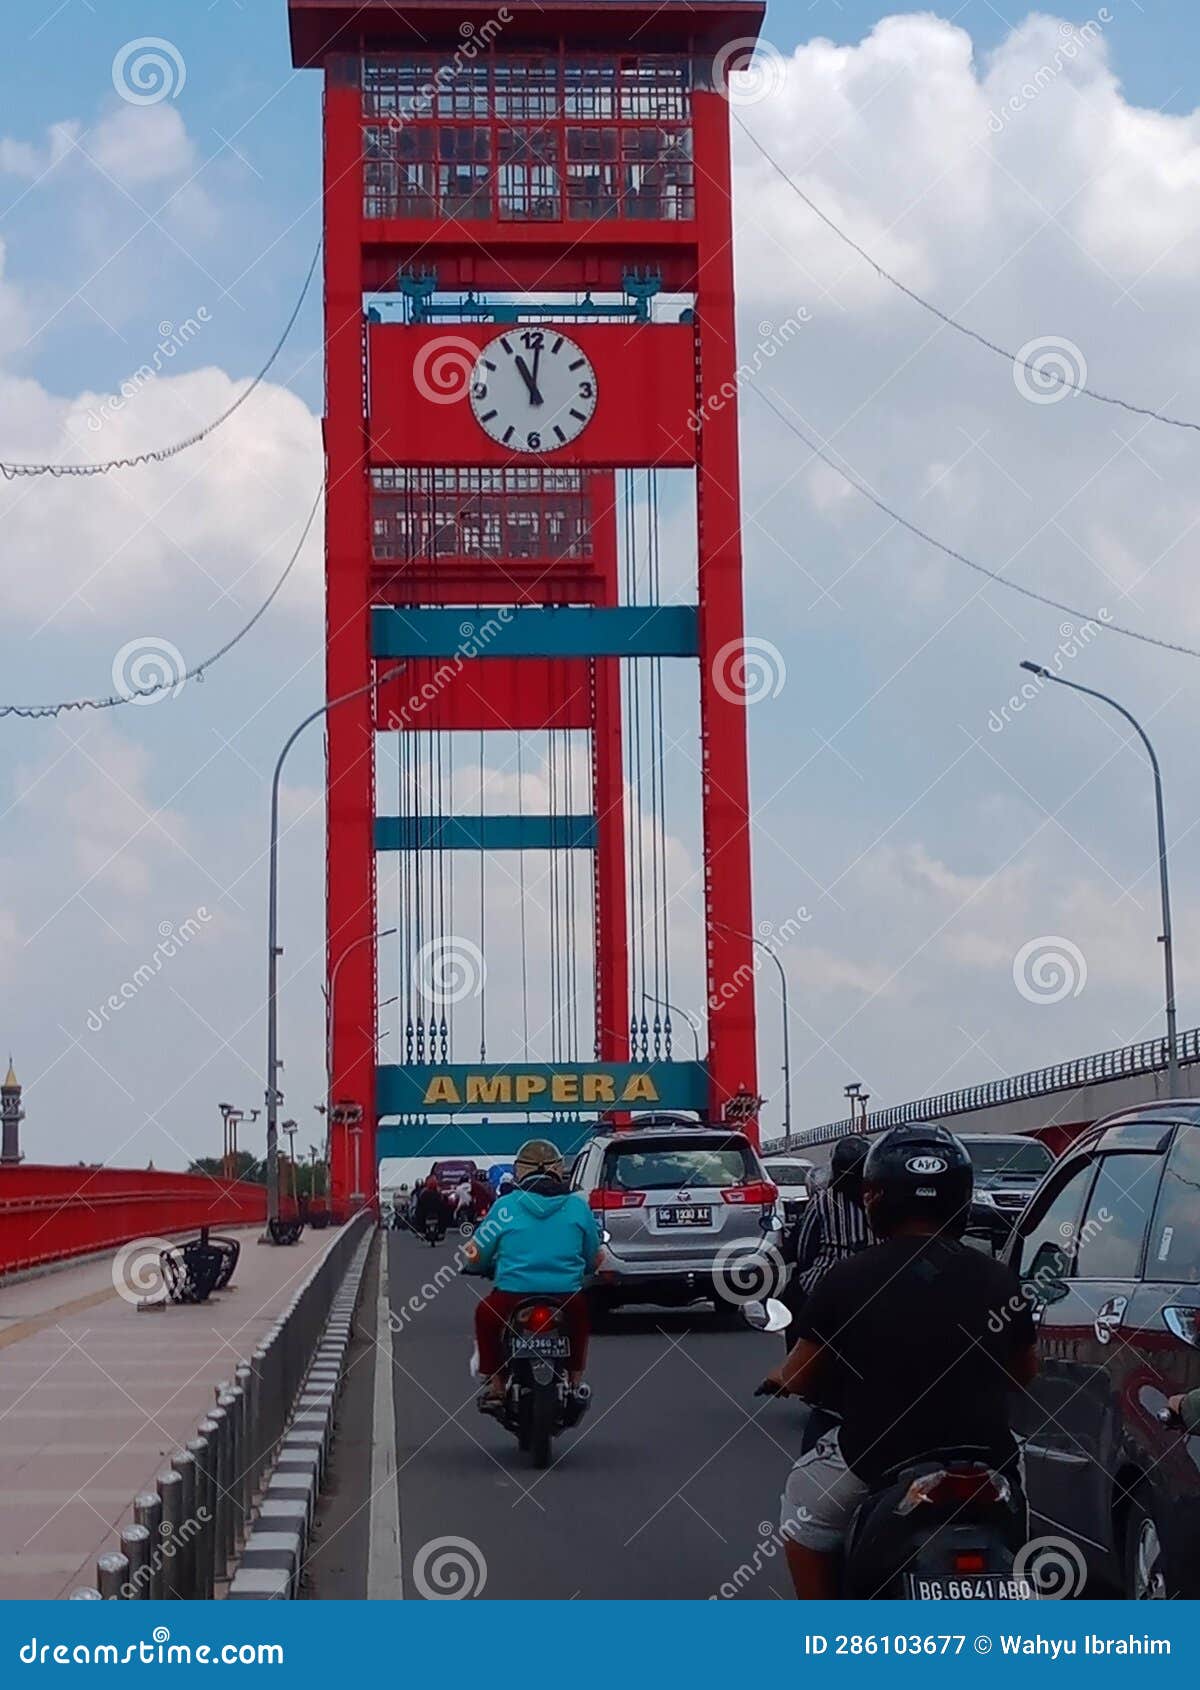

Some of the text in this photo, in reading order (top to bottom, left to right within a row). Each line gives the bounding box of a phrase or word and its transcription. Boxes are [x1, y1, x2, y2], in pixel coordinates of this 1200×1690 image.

[520, 332, 544, 350] 12
[473, 382, 487, 400] 9
[579, 382, 593, 399] 3
[527, 432, 541, 449] 6
[422, 1074, 660, 1104] AMPERA
